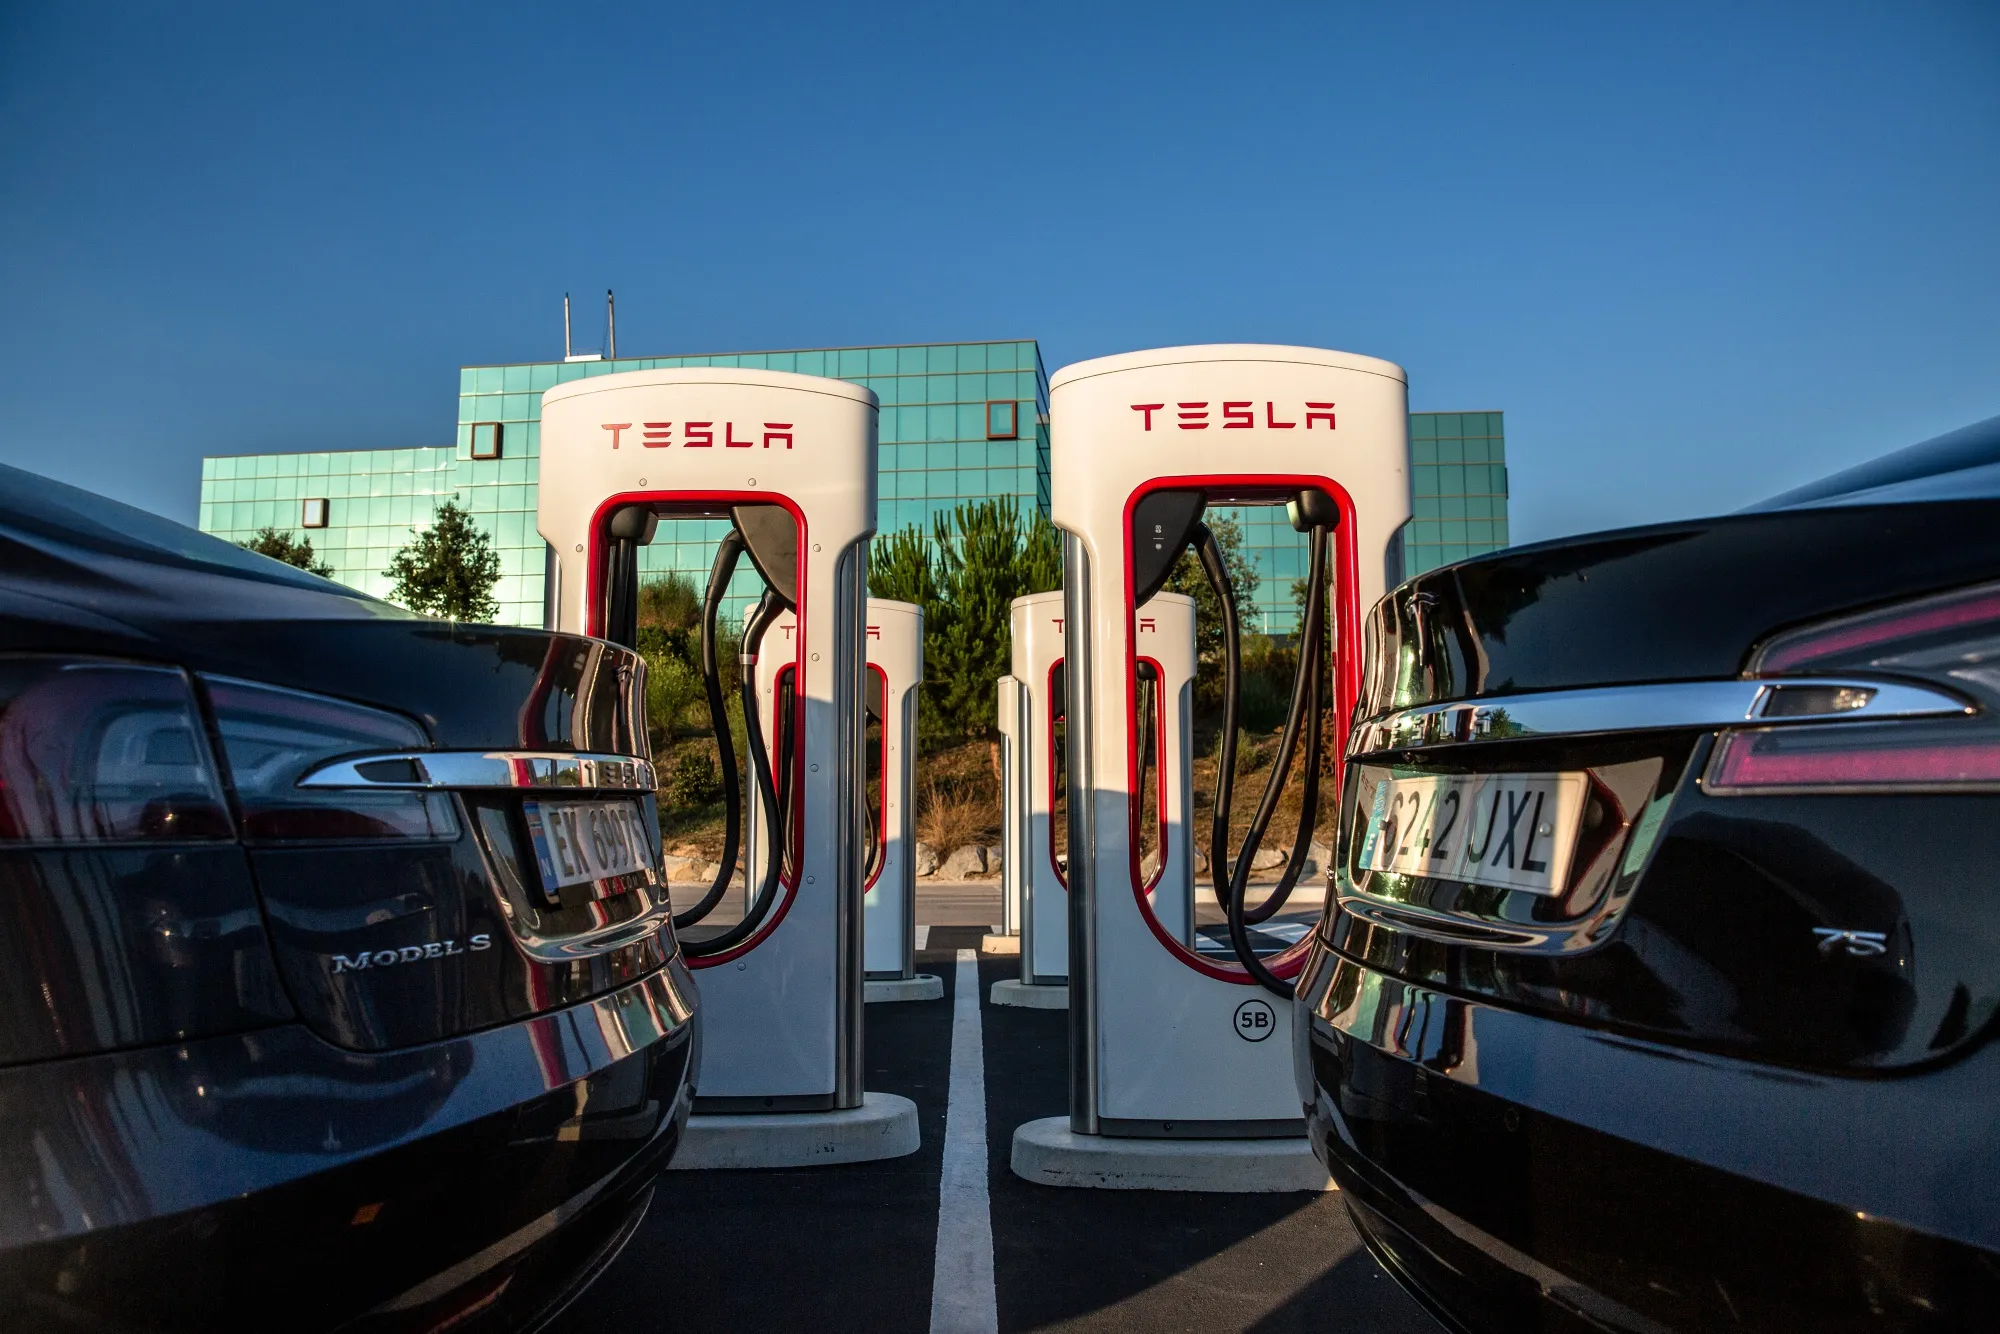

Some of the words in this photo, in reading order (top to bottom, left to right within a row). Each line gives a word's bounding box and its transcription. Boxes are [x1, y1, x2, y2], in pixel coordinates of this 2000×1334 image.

[1130, 401, 1336, 431] TESLA
[601, 421, 794, 449] TESLA
[547, 809, 591, 878] EK
[1382, 789, 1461, 860] 6242
[1467, 789, 1548, 873] JXL
[331, 939, 464, 974] MODEL
[469, 933, 492, 951] S
[1240, 1011, 1269, 1028] 5B
